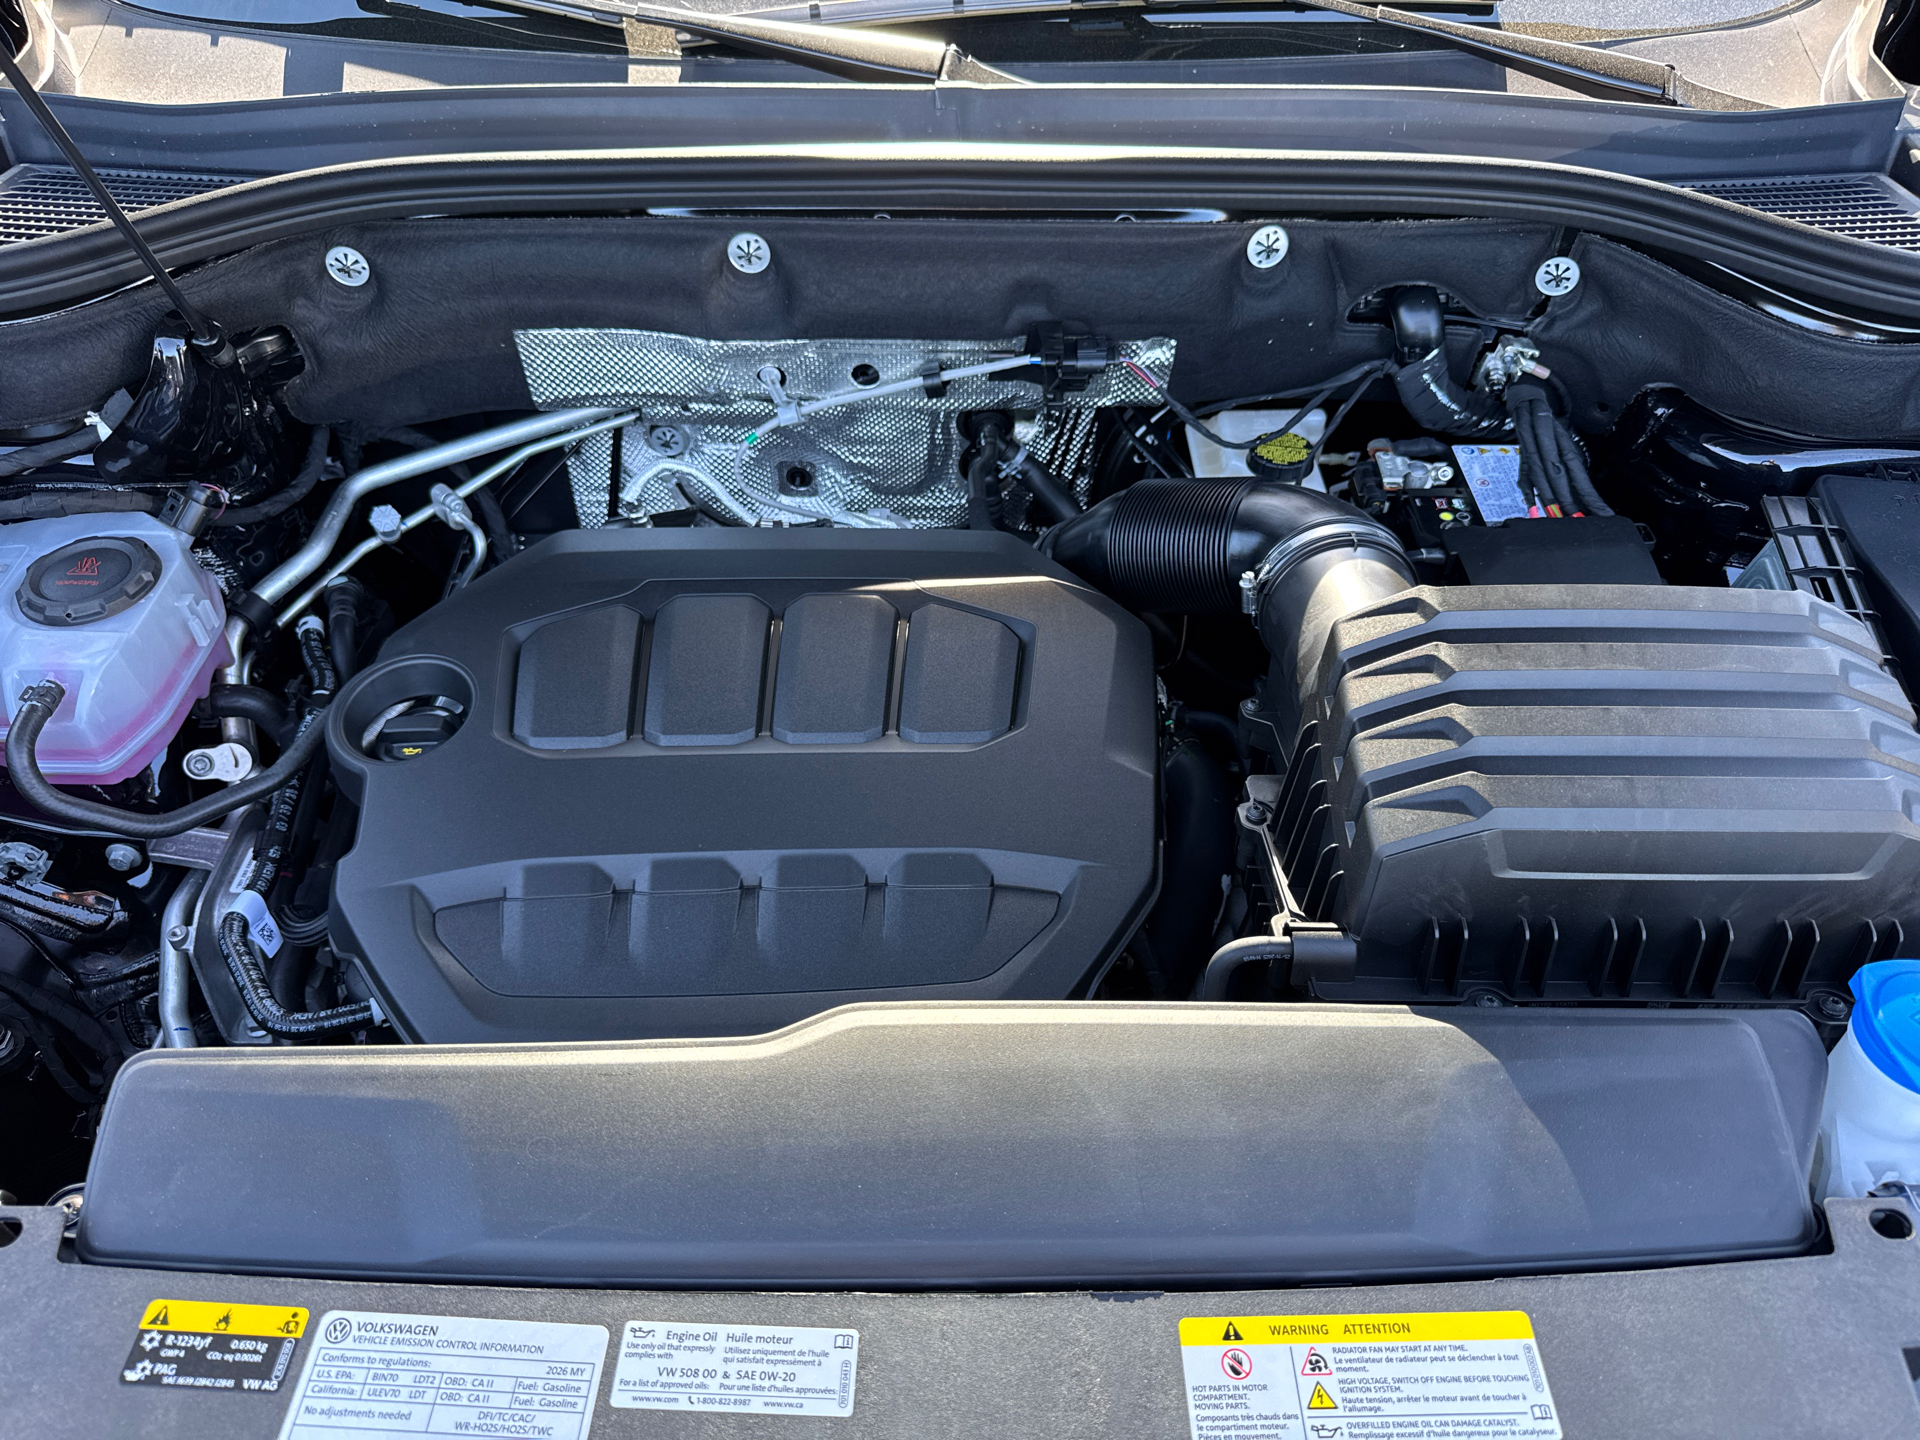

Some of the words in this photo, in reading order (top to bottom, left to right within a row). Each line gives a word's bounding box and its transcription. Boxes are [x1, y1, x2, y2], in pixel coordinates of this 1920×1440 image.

[357, 1322, 439, 1336] VOLKSWAGEN
[1269, 1325, 1329, 1336] WARNING
[1343, 1323, 1411, 1335] ATTENTION
[666, 1331, 701, 1343] Engine
[702, 1332, 718, 1342] Oil
[726, 1333, 753, 1344] Huile
[755, 1335, 793, 1345] moteur
[256, 1341, 268, 1354] kg
[352, 1335, 389, 1345] VEHICLE
[390, 1337, 434, 1347] EMISSION
[436, 1340, 478, 1350] CONTROL
[480, 1342, 544, 1354] INFORMATION
[641, 1343, 656, 1351] only
[667, 1343, 681, 1351] that
[683, 1345, 715, 1354] expressly
[1332, 1346, 1368, 1354] RADIATOR
[1401, 1345, 1422, 1353] START
[624, 1351, 656, 1360] complies
[657, 1352, 674, 1360] with
[724, 1347, 751, 1355] Utilisez
[752, 1348, 796, 1357] uniquement
[797, 1349, 807, 1357] de
[807, 1349, 830, 1358] l'huile
[322, 1353, 365, 1364] Conforms
[367, 1355, 377, 1365] to
[378, 1356, 432, 1368] regulations:
[722, 1356, 735, 1364] qui
[736, 1356, 764, 1364] satisfait
[765, 1358, 816, 1367] expressément
[1344, 1356, 1383, 1364] ventilateur
[1395, 1355, 1428, 1363] radiateur
[1429, 1356, 1446, 1364] peut
[1457, 1354, 1496, 1362] déclencher
[153, 1363, 178, 1375] PAG
[546, 1366, 568, 1376] 2026
[570, 1367, 586, 1377] MY
[657, 1367, 678, 1377] VW
[679, 1368, 700, 1378] 508
[702, 1369, 718, 1379] 00
[722, 1371, 731, 1380] &
[736, 1370, 757, 1380] SAE
[759, 1371, 797, 1382] 0W-20
[242, 1378, 262, 1390] VW
[261, 1380, 278, 1391] AG
[316, 1369, 333, 1379] U.S.
[335, 1371, 355, 1380] EPA:
[372, 1372, 399, 1383] BIN70
[413, 1375, 436, 1385] LDT2
[444, 1377, 468, 1387] OBD:
[471, 1378, 485, 1388] CA
[517, 1381, 539, 1391] Fuel:
[543, 1383, 582, 1393] Gasoline
[638, 1379, 650, 1387] list
[650, 1380, 660, 1388] of
[659, 1381, 695, 1390] approved
[694, 1382, 710, 1390] oils:
[1358, 1378, 1391, 1386] VOLTAGE,
[1463, 1375, 1491, 1383] BEFORE
[1492, 1374, 1530, 1382] TOUCHING
[719, 1383, 739, 1391] Pour
[751, 1384, 766, 1392] liste
[767, 1385, 795, 1393] d'huiles
[1241, 1384, 1268, 1392] MOTOR
[1339, 1386, 1372, 1394] IGNITION
[311, 1384, 358, 1396] California:
[367, 1388, 401, 1398] ULEV70
[409, 1390, 427, 1399] LDT
[440, 1392, 463, 1402] OBD:
[467, 1393, 480, 1403] CA
[513, 1396, 535, 1406] Fuel:
[539, 1398, 578, 1409] Gasoline
[1193, 1393, 1250, 1402] COMPARTMENT.
[1365, 1396, 1396, 1405] tension,
[1492, 1393, 1520, 1401] toucher
[1225, 1402, 1250, 1410] PARTS.
[304, 1405, 318, 1415] No
[319, 1406, 376, 1419] adjustments
[377, 1411, 412, 1421] needed
[478, 1411, 536, 1423] DFI/TC/CAC/
[1196, 1414, 1240, 1423] Composants
[1240, 1413, 1255, 1421] très
[1256, 1413, 1281, 1421] chauds
[1281, 1412, 1299, 1420] dans
[1197, 1424, 1204, 1432] le
[1205, 1423, 1258, 1432] compartiment
[1346, 1422, 1390, 1430] OVERFILLED
[1392, 1421, 1419, 1429] ENGINE
[1421, 1420, 1433, 1428] OIL
[1434, 1420, 1450, 1428] CAN
[1483, 1419, 1520, 1427] CATALYST.
[1348, 1431, 1394, 1440] Remplissage
[1396, 1430, 1424, 1438] excessif
[1452, 1429, 1490, 1438] dangereux
[1492, 1430, 1508, 1438] pour
